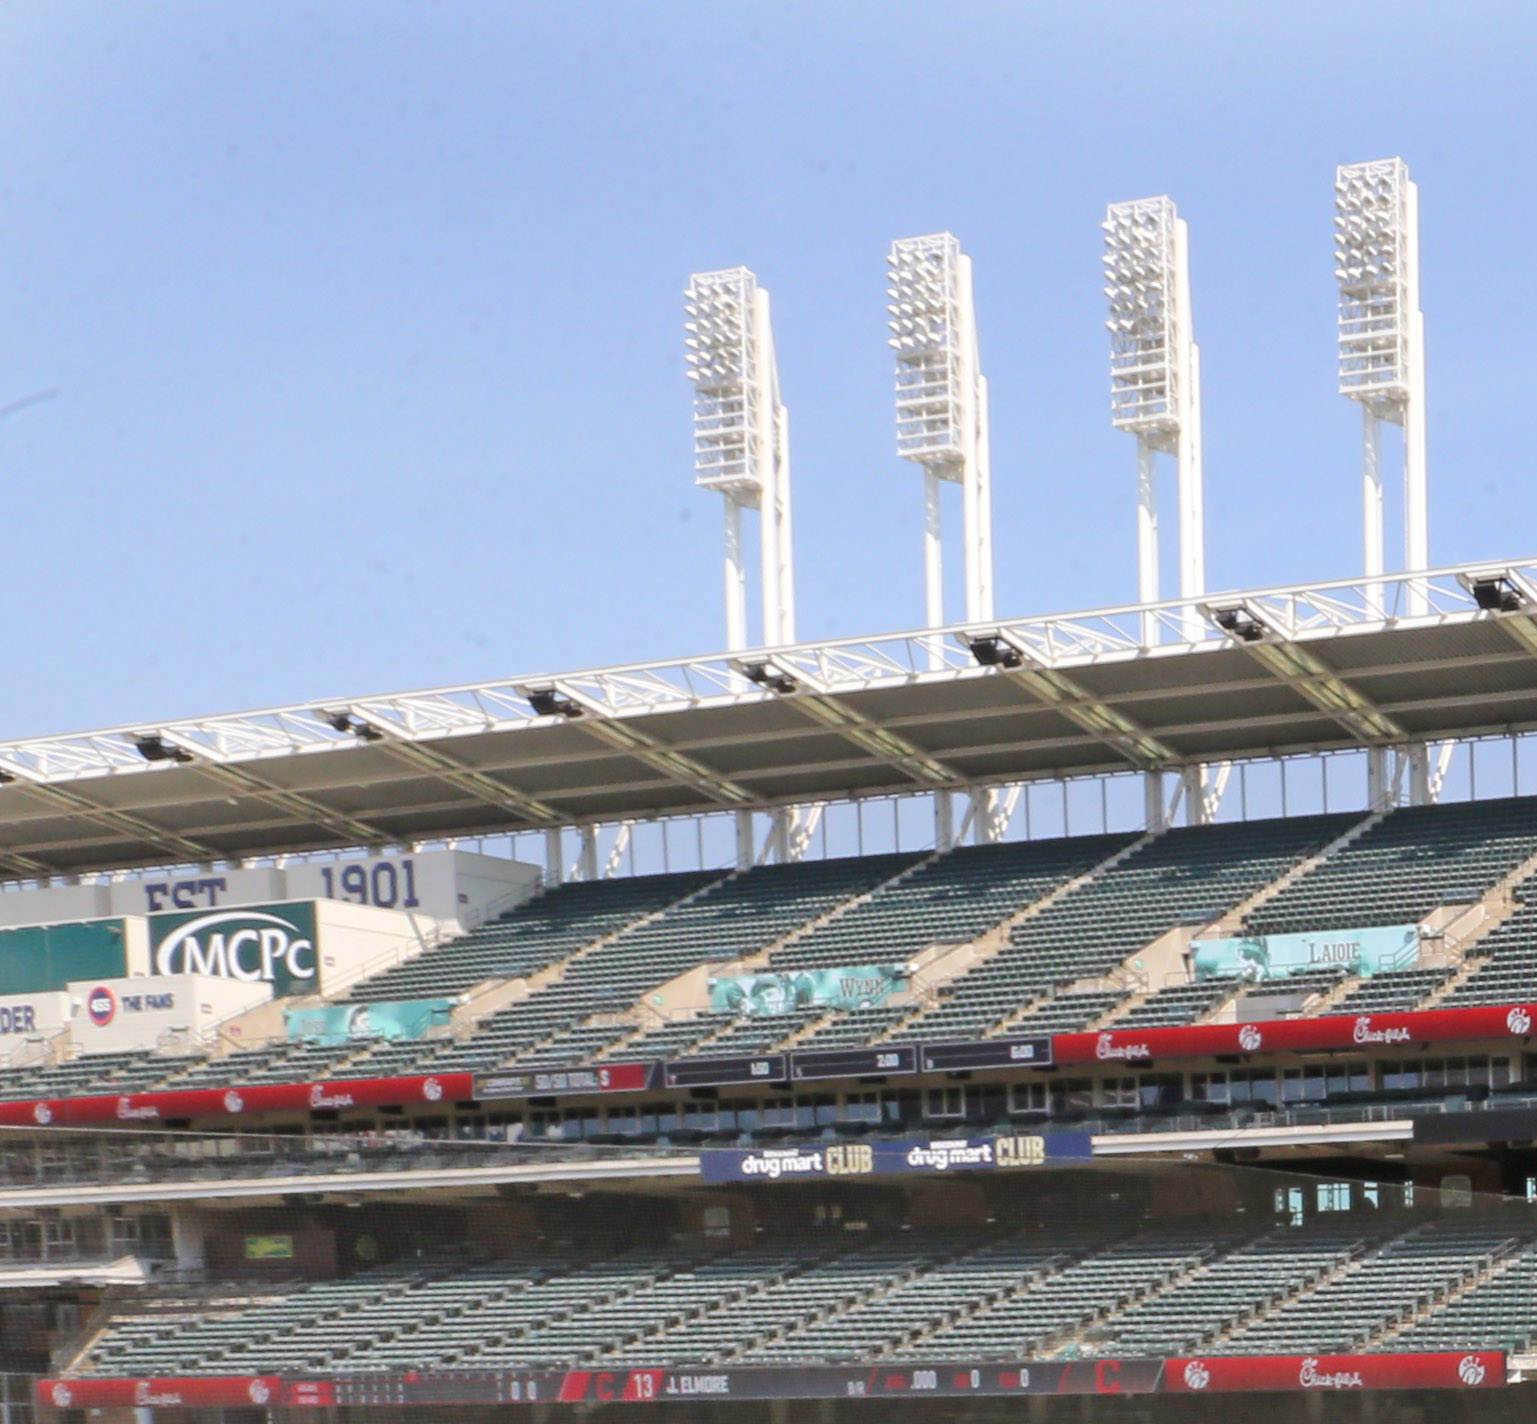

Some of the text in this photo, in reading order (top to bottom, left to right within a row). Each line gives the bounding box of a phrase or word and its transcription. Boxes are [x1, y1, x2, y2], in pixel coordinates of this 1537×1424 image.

[321, 860, 419, 908] 1901
[121, 996, 142, 1011] THE
[742, 1145, 873, 1178] drug mart CLUB
[995, 1135, 1045, 1166] CLUB
[634, 1374, 653, 1398] 13
